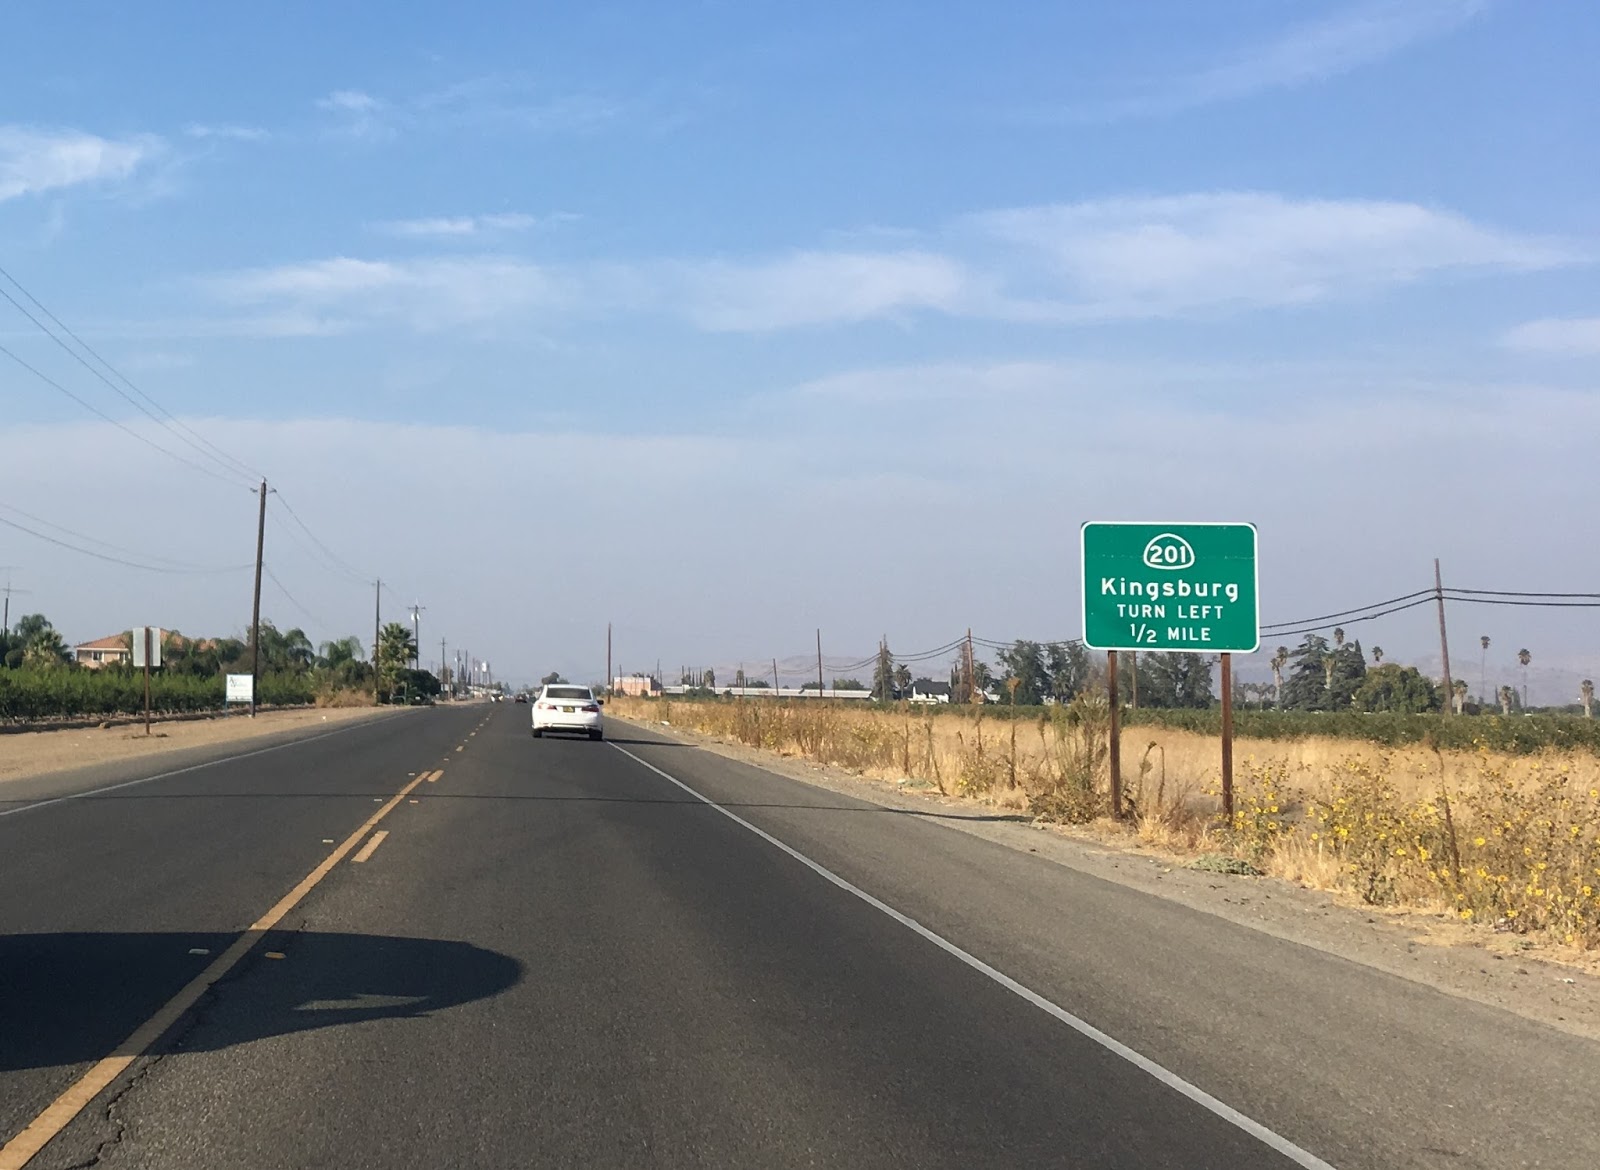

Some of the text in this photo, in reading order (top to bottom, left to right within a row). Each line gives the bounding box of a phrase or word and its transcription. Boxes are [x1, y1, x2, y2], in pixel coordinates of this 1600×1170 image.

[1150, 545, 1187, 563] 201
[1101, 577, 1239, 603] Kingsburg
[1117, 604, 1224, 620] TURN LEFT
[1130, 623, 1211, 643] 1/2 MILE
